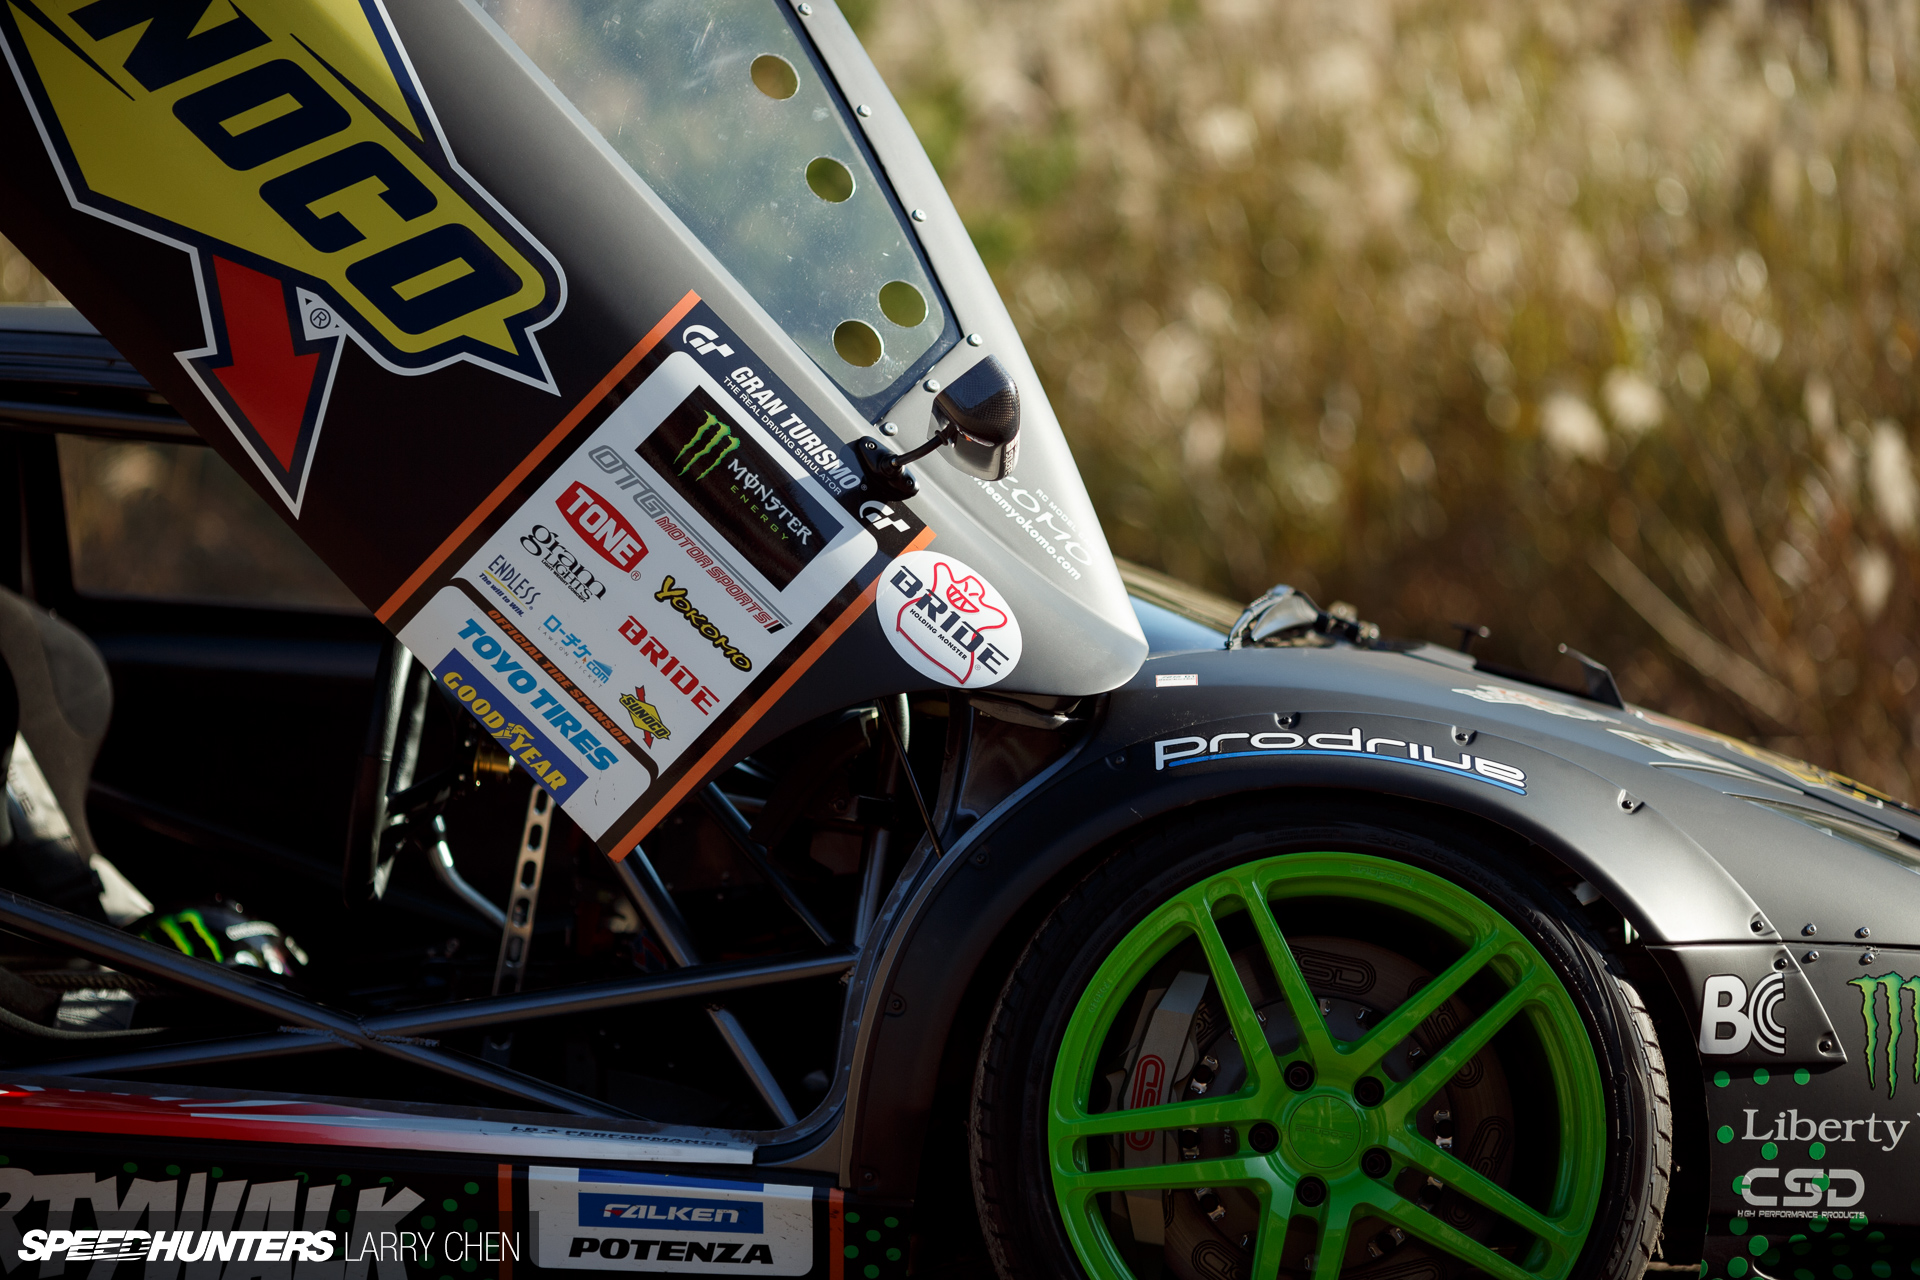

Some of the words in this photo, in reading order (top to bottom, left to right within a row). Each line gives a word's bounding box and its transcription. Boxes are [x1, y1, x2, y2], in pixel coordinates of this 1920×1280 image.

[722, 376, 741, 395] THE
[739, 393, 761, 416] REAL
[760, 413, 795, 450] DRIVING
[794, 447, 842, 496] SIMULATOR
[730, 366, 788, 417] GRAN
[780, 412, 861, 489] TURISMO
[565, 486, 643, 567] TONE
[727, 458, 813, 545] MONSTER
[730, 485, 789, 540] ENERGY
[1035, 488, 1049, 502] RC
[1048, 501, 1077, 532] MODEL
[479, 572, 492, 586] The
[490, 584, 505, 597] will
[501, 595, 511, 604] to
[487, 554, 541, 605] ENDLESS
[519, 524, 606, 600] gram
[541, 559, 554, 572] LIGHT
[553, 570, 569, 586] WEIGHT
[567, 584, 587, 603] CONCEPT
[543, 552, 593, 600] LIGHTS
[890, 565, 1010, 675] BRIDE
[909, 608, 938, 635] HOLDING
[937, 633, 968, 661] MONSTER
[487, 609, 543, 664] OFFICIAL
[541, 659, 578, 692] TIRE
[569, 688, 631, 746] SPONSOR
[537, 625, 570, 657] LAWSON
[574, 660, 603, 688] TICKET
[617, 615, 722, 716] BRIDE
[457, 618, 538, 695] TOYO
[530, 688, 619, 771] TIRES
[620, 695, 670, 739] SUNOCO
[565, 1130, 729, 1147] PERFORMANCE
[1741, 1109, 1910, 1151] Liberty
[1741, 1168, 1865, 1207] CSD
[1758, 1210, 1818, 1219] PERFORMANCE
[1821, 1210, 1865, 1219] PRODUCTS
[568, 1237, 774, 1265] POTENZA
